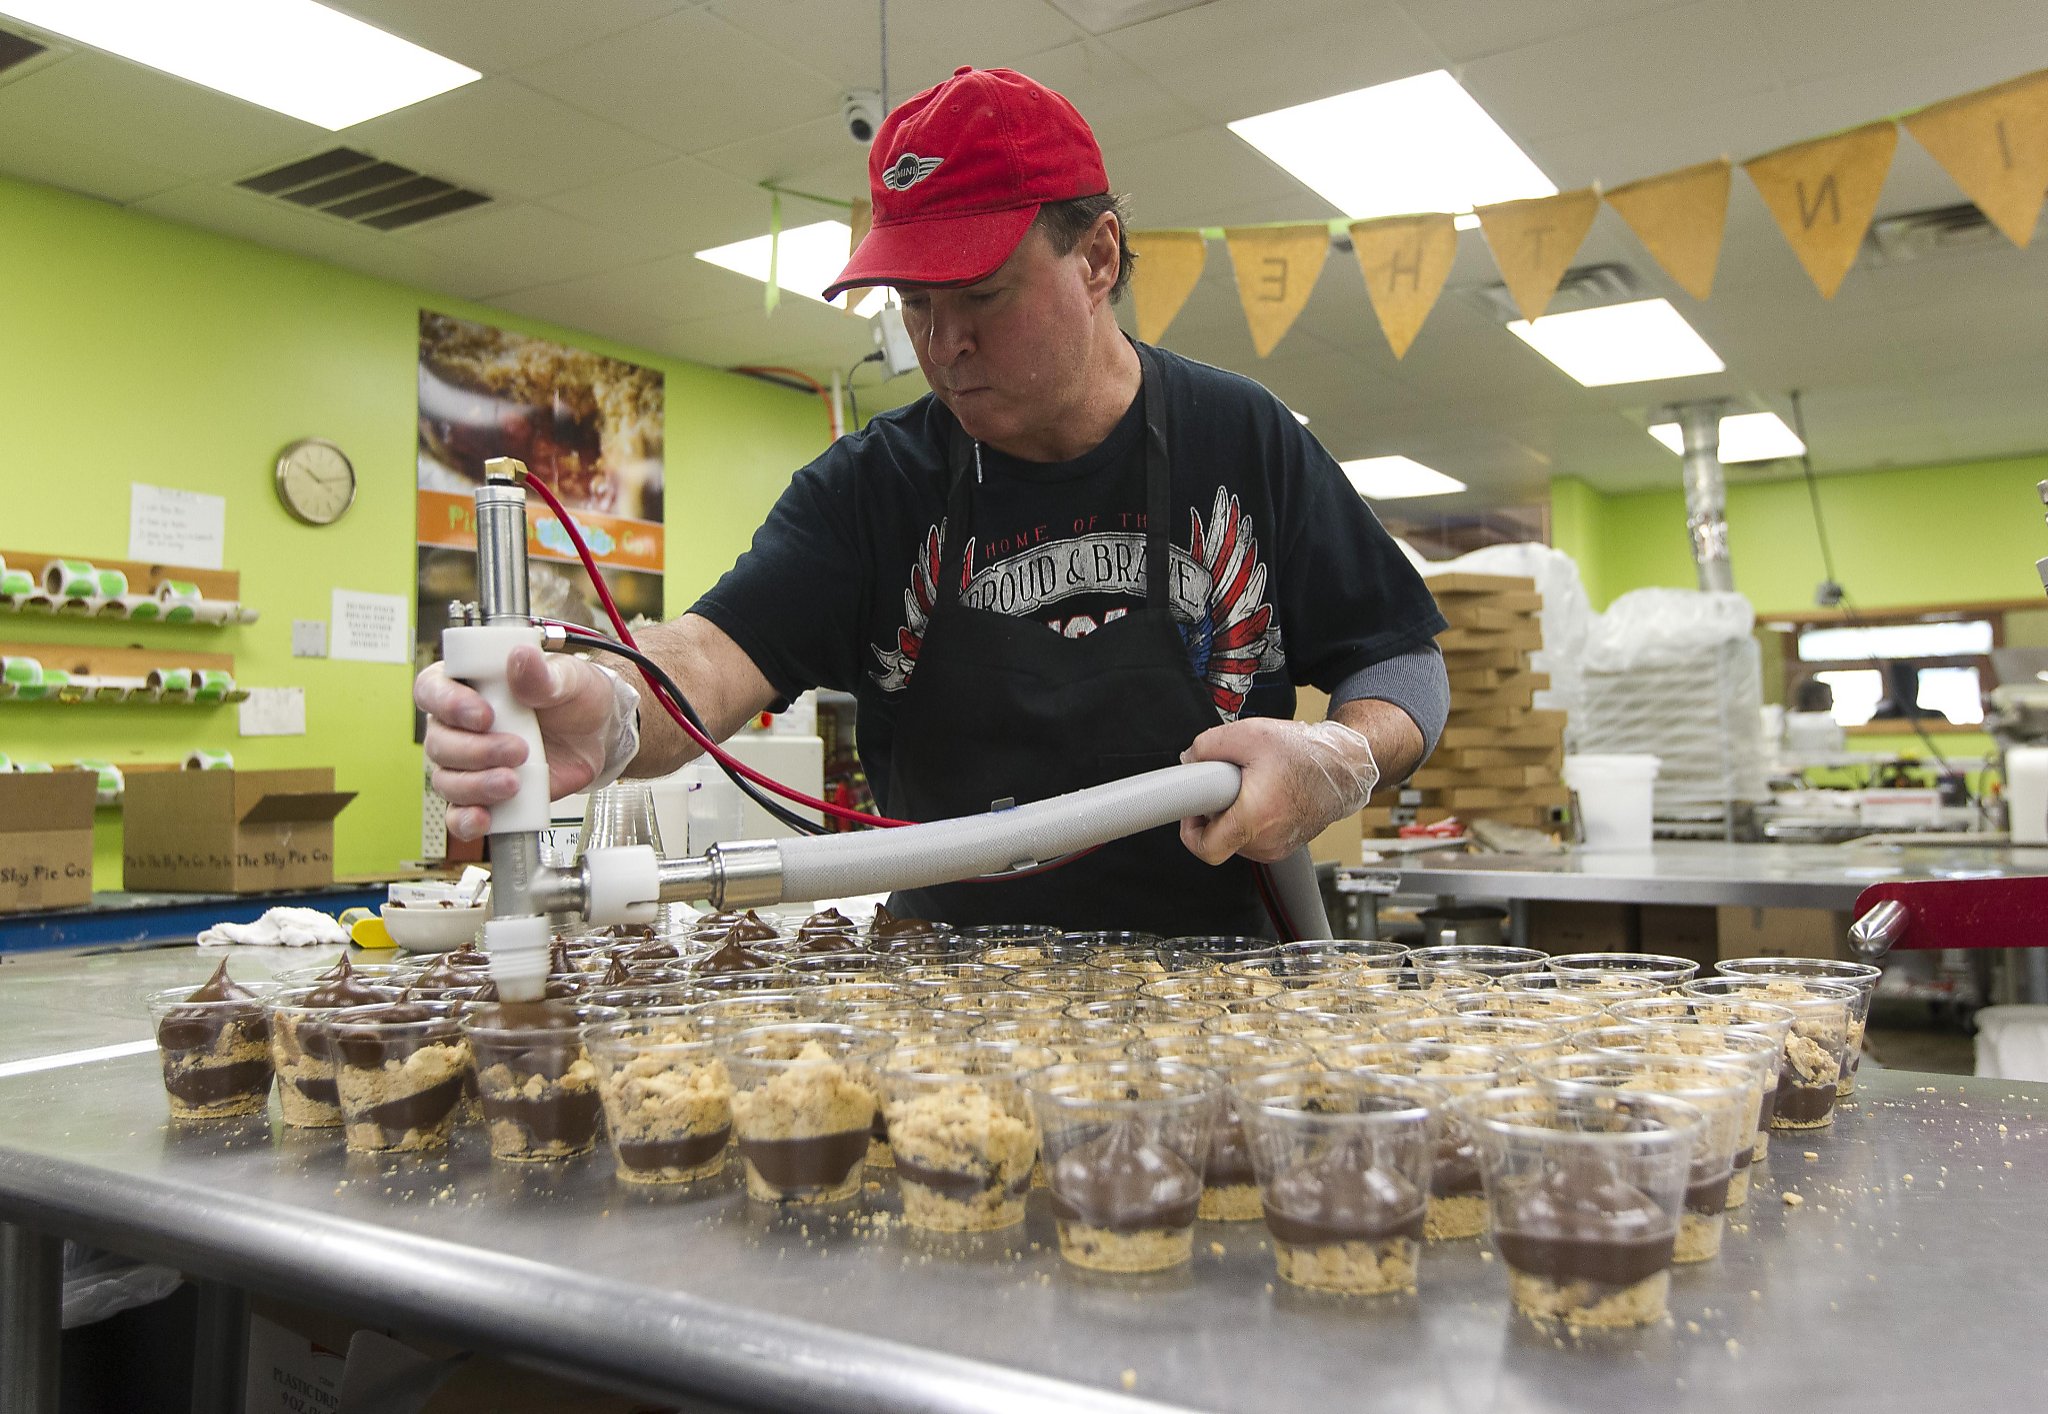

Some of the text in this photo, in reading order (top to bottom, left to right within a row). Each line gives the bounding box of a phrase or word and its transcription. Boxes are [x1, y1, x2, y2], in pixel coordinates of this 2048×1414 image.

[897, 166, 918, 178] MINI
[448, 504, 477, 534] Pi
[984, 512, 1147, 559] HOME OF TH
[1066, 549, 1085, 585] &
[237, 853, 259, 868] The
[264, 852, 285, 870] Sky
[289, 850, 306, 865] Pie
[1, 866, 29, 887] Sky
[33, 864, 58, 880] Pie
[273, 1367, 313, 1399] PLASTIC
[282, 1392, 289, 1406] 9
